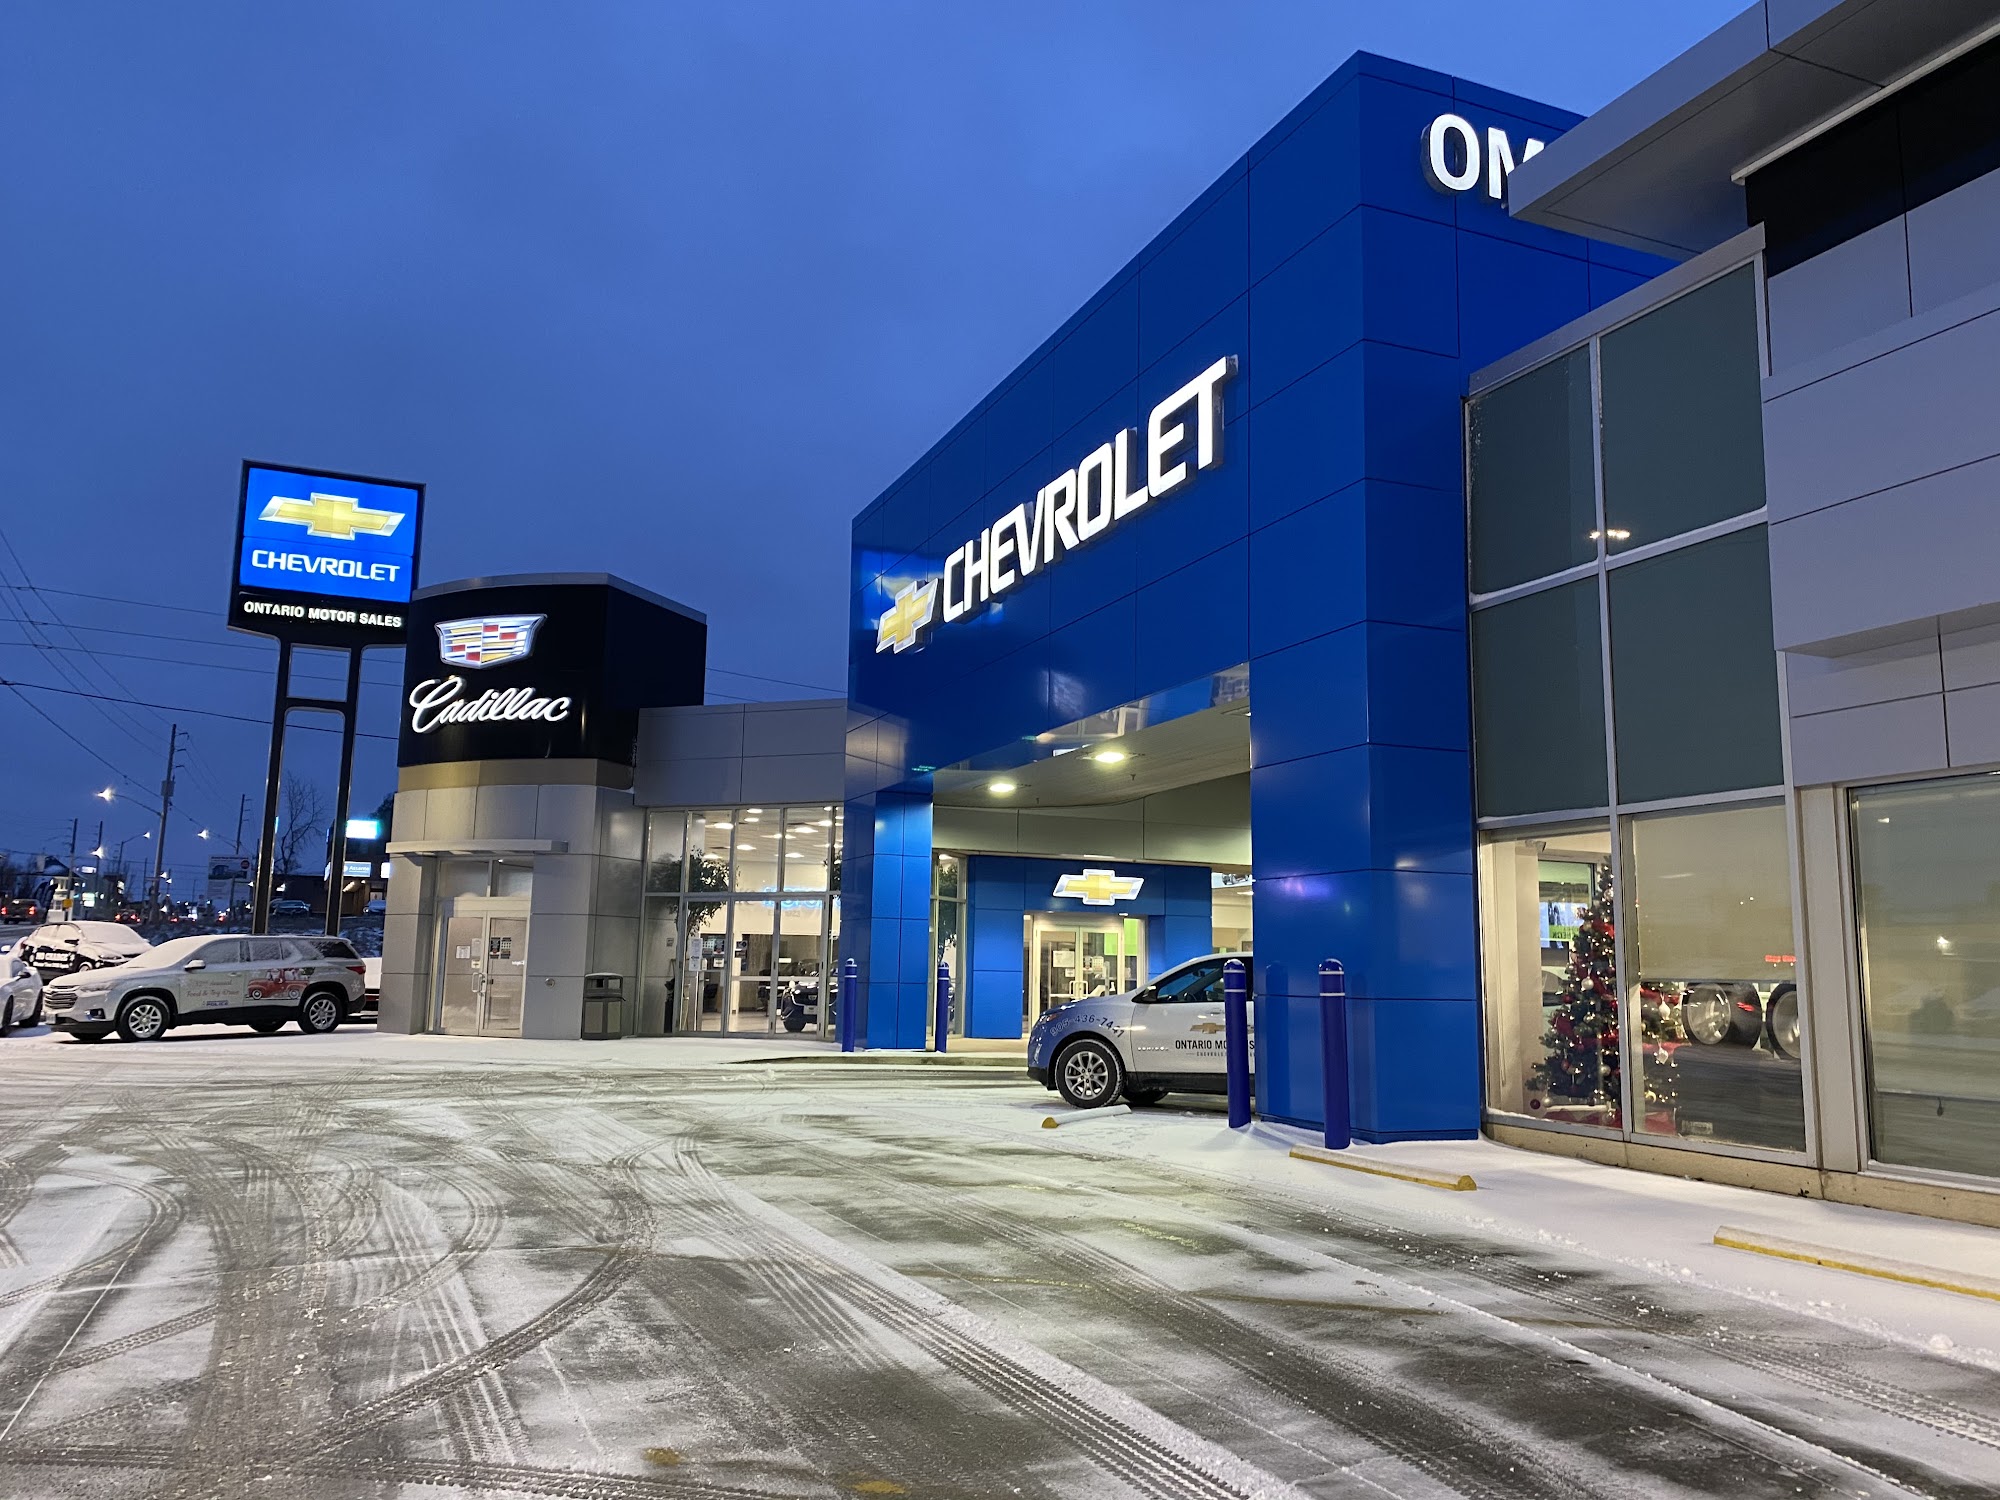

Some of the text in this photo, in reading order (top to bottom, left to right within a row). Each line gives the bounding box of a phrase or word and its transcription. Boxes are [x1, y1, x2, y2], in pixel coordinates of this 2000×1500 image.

[942, 356, 1230, 624] CHEVROLET
[251, 549, 401, 583] CHEVROLET
[243, 601, 402, 628] ONTARIO MOTOR SALES
[409, 675, 571, 734] Cadillac
[1175, 1039, 1212, 1050] ONTARIO
